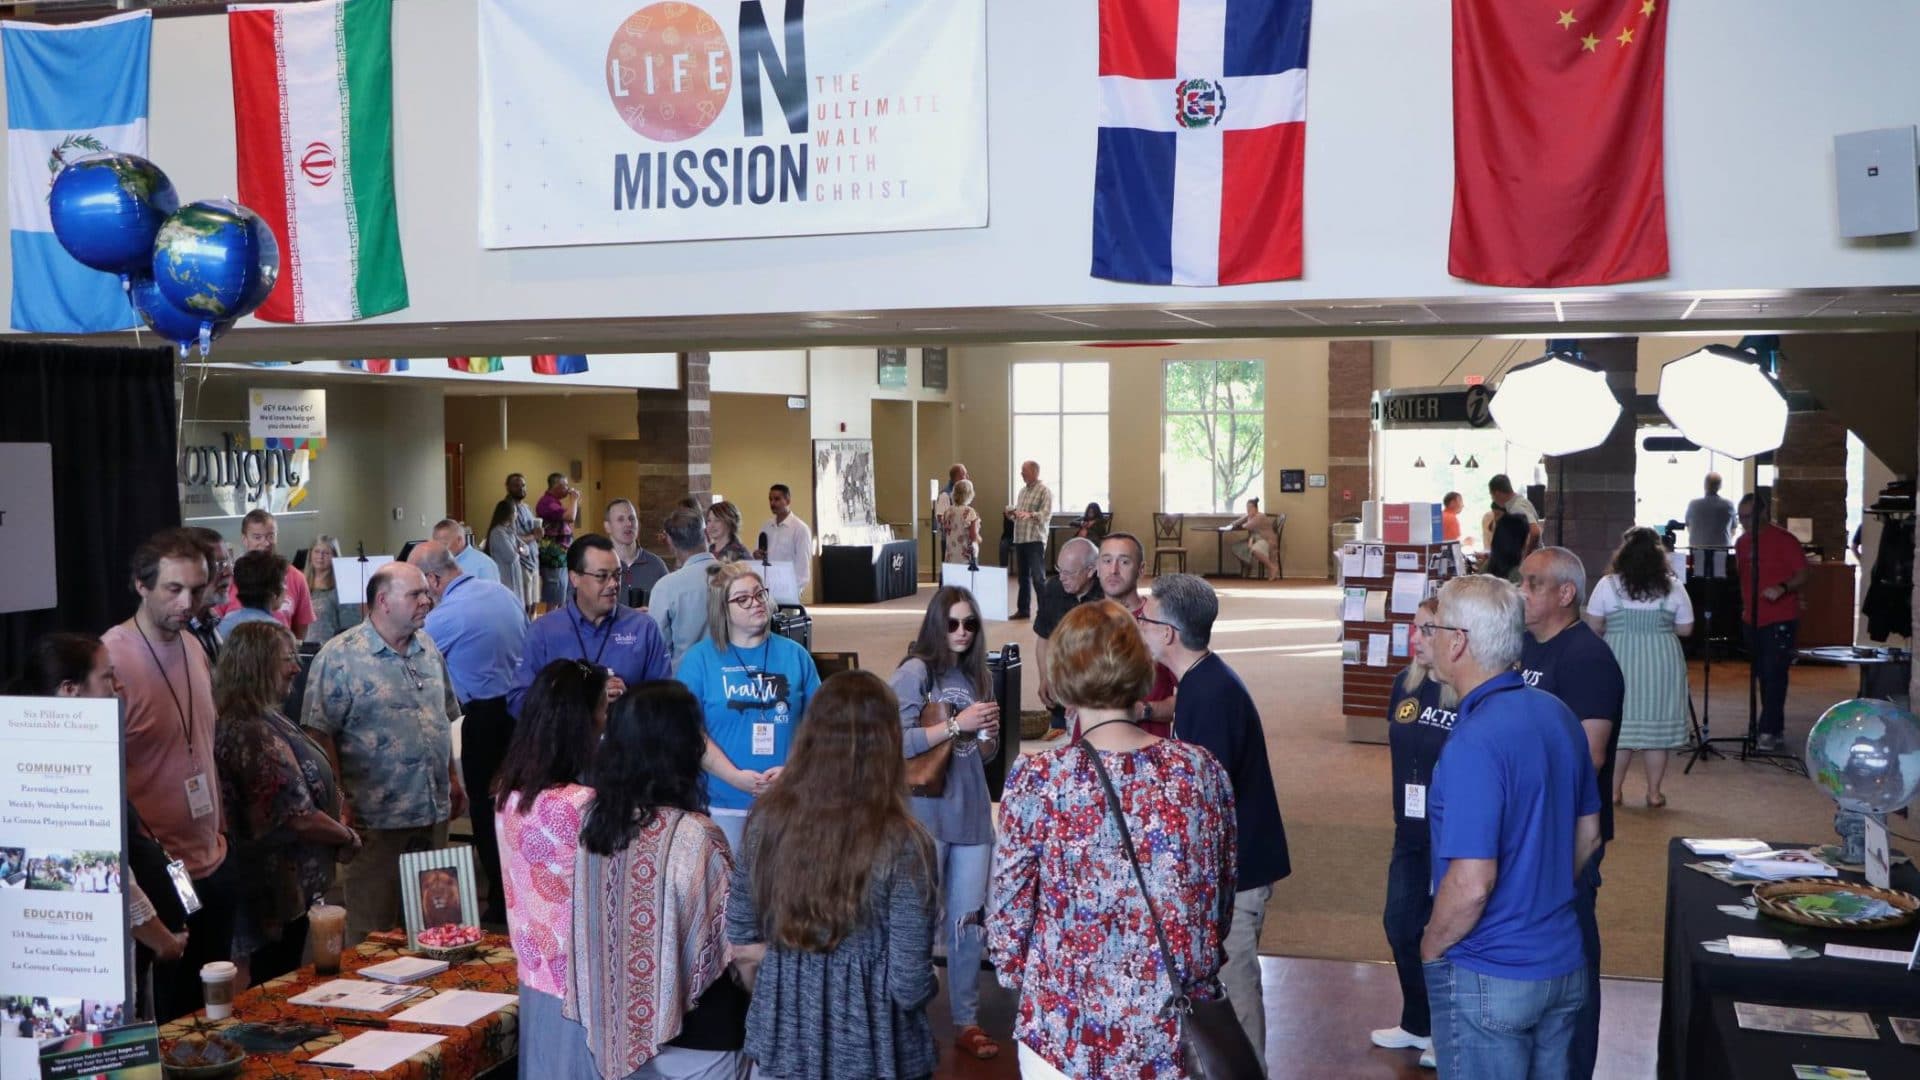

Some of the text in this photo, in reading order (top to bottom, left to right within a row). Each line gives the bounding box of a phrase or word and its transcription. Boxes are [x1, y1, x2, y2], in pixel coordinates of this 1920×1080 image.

[612, 51, 726, 97] LIFE
[816, 73, 860, 93] THE
[817, 96, 940, 121] ULTIMATE
[817, 126, 878, 148] WALK
[816, 154, 876, 175] WITH
[614, 143, 808, 210] MISSION
[816, 180, 908, 202] CHRIST
[23, 709, 37, 719] Six
[39, 709, 70, 719] Pillars
[1420, 706, 1458, 726] ACTS
[8, 719, 100, 731] Sustainable Change
[16, 762, 92, 774] COMMUNITY
[23, 908, 94, 921] EDUCATION
